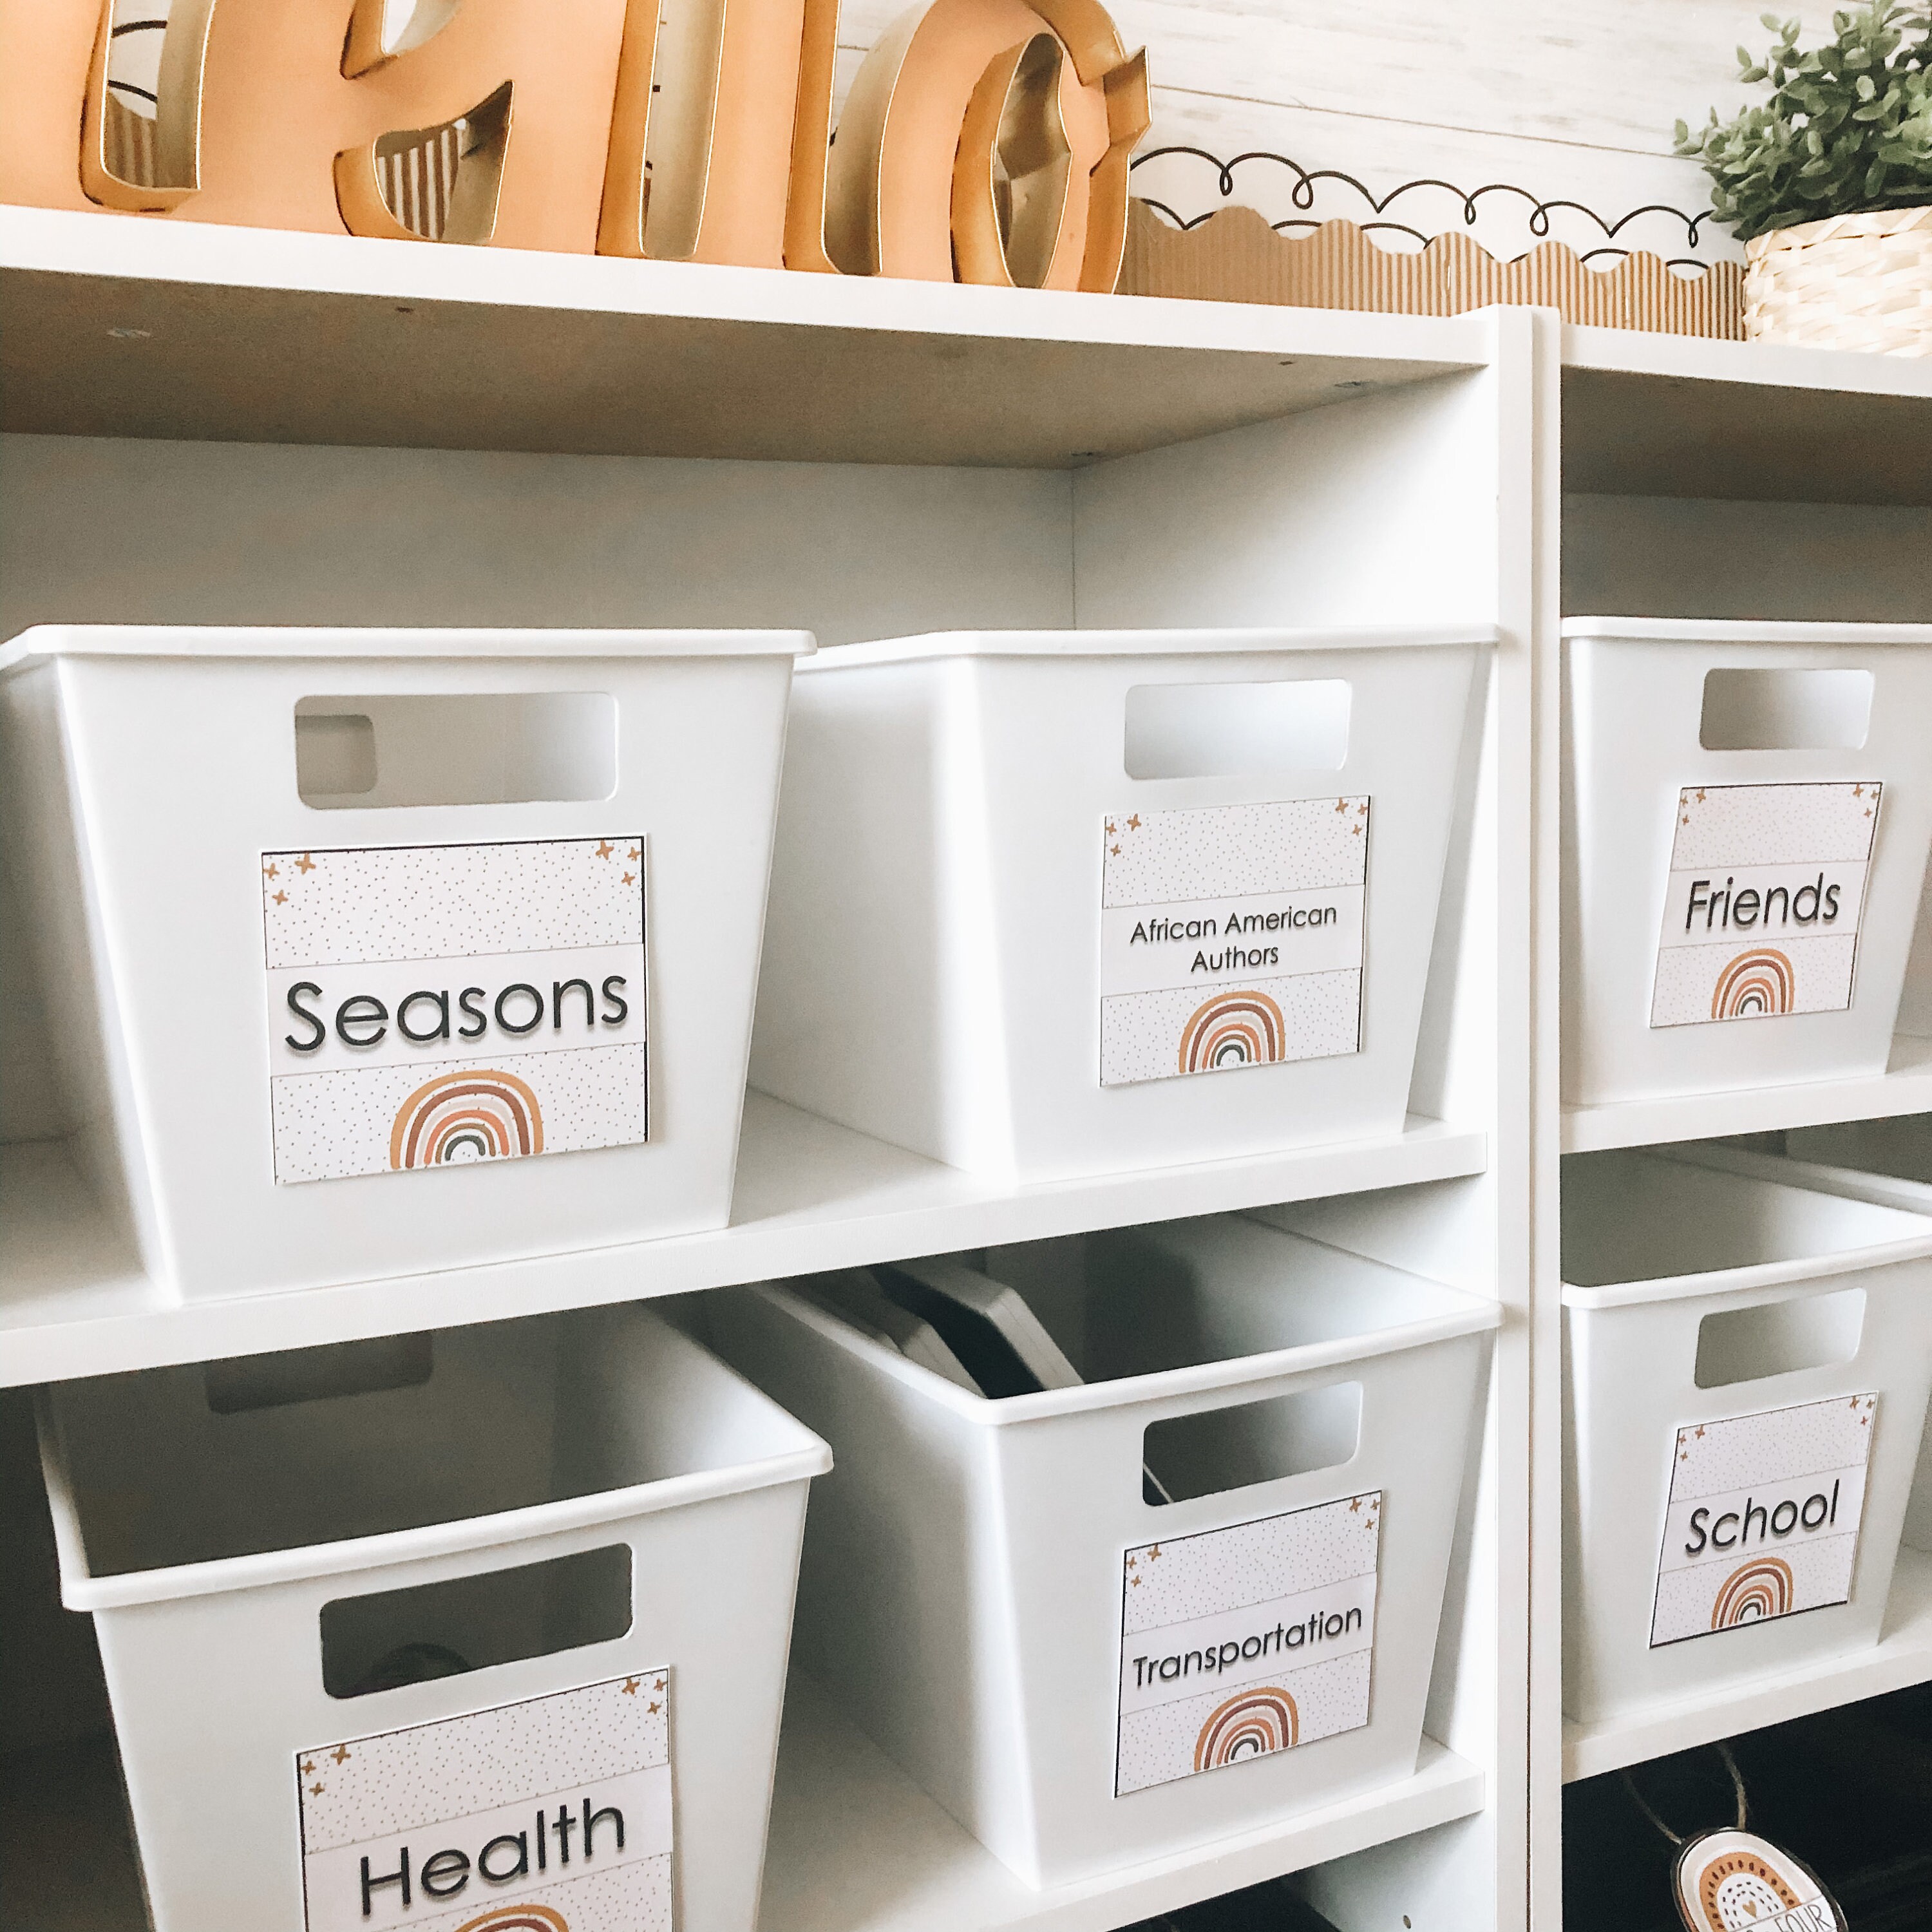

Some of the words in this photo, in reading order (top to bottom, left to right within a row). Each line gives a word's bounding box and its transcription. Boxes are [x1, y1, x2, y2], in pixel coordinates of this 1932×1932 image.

[1130, 917, 1217, 945] African
[1224, 905, 1337, 934] American
[1685, 872, 1841, 929] Friends
[1190, 946, 1279, 972] Authors
[285, 974, 629, 1052] Seasons
[1685, 1479, 1840, 1553] School
[1133, 1607, 1362, 1686] Transportation
[359, 1797, 625, 1915] Health
